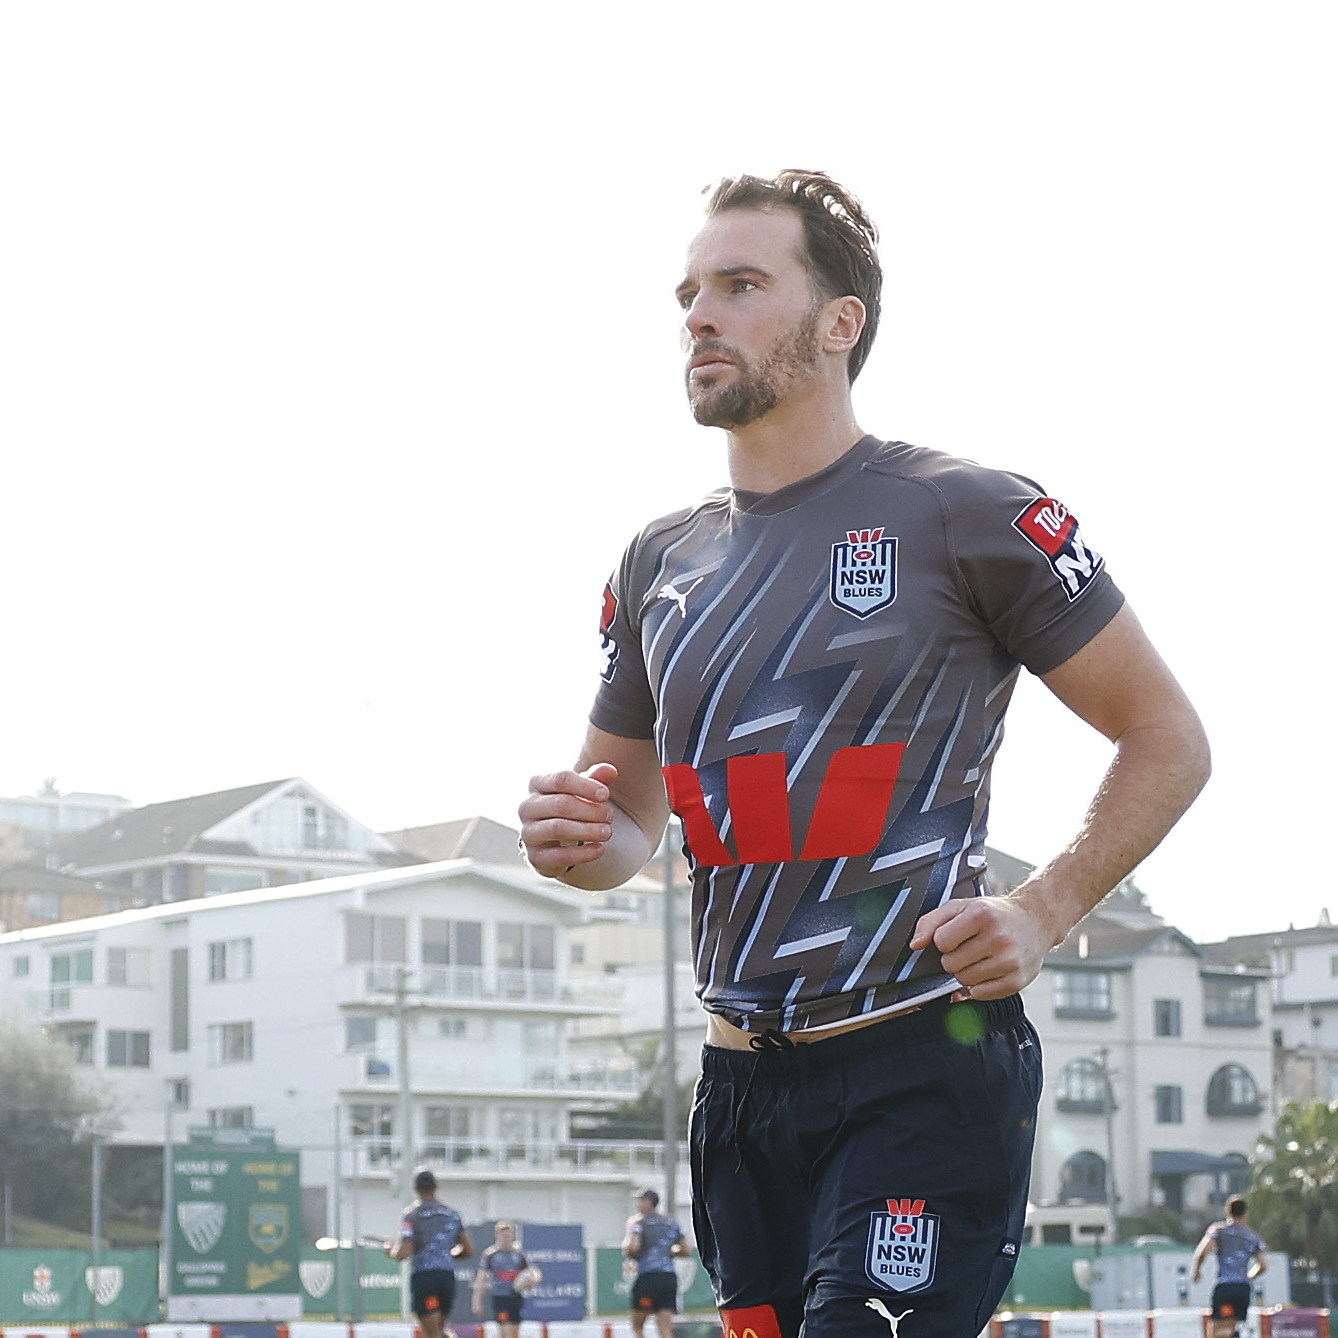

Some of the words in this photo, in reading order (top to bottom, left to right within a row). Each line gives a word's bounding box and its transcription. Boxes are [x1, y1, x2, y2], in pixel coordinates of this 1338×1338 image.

[840, 568, 887, 587] NSW
[843, 587, 883, 598] BLUES
[876, 1244, 927, 1265] NSW
[879, 1263, 922, 1278] BLUES
